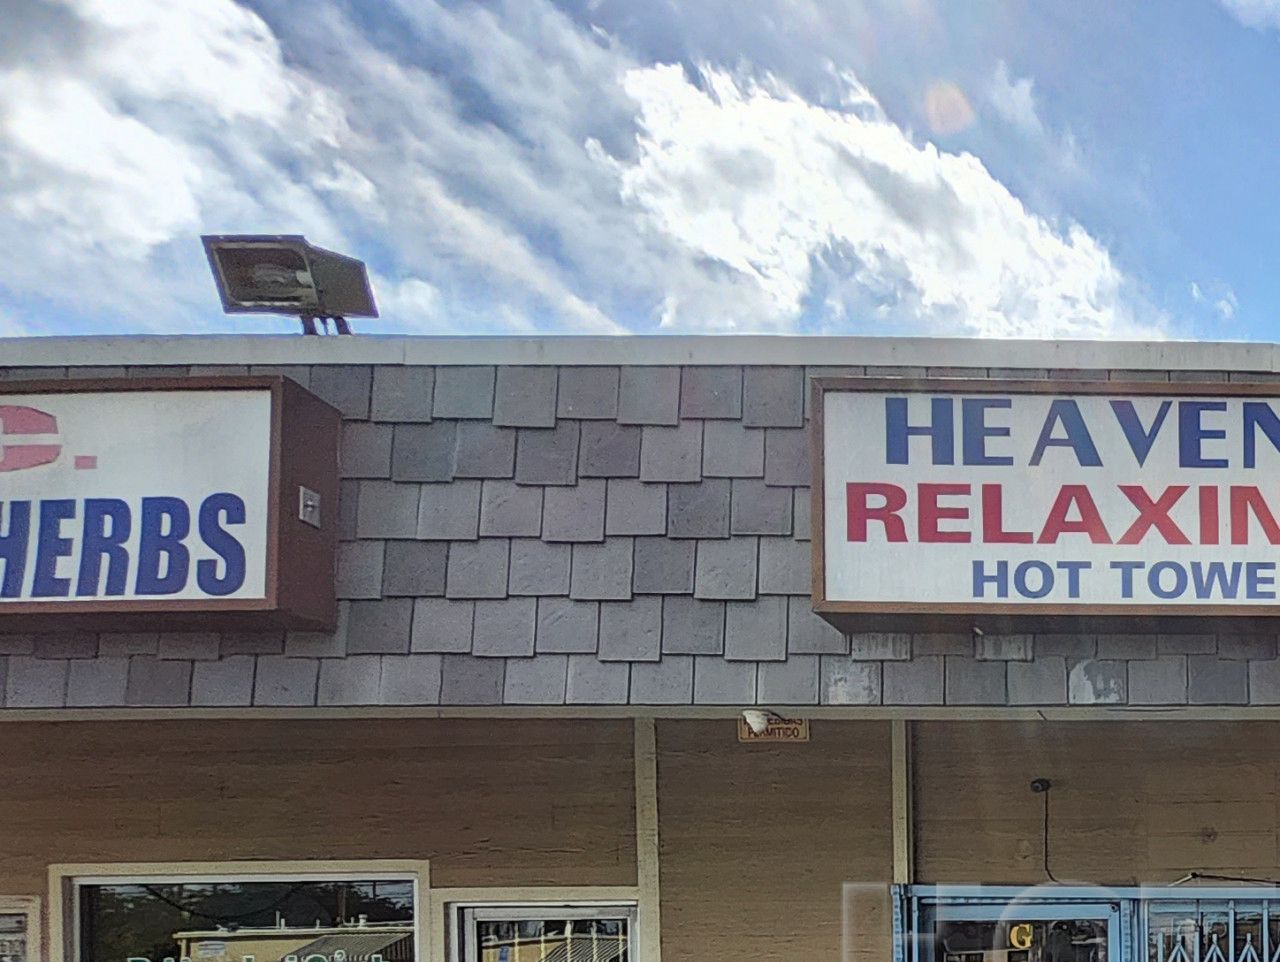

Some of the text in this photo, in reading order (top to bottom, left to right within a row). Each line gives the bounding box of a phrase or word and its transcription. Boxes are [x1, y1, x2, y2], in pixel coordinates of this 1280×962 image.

[0, 492, 247, 597] HERBS
[971, 559, 1106, 600] HOT
[1010, 923, 1034, 949] G
